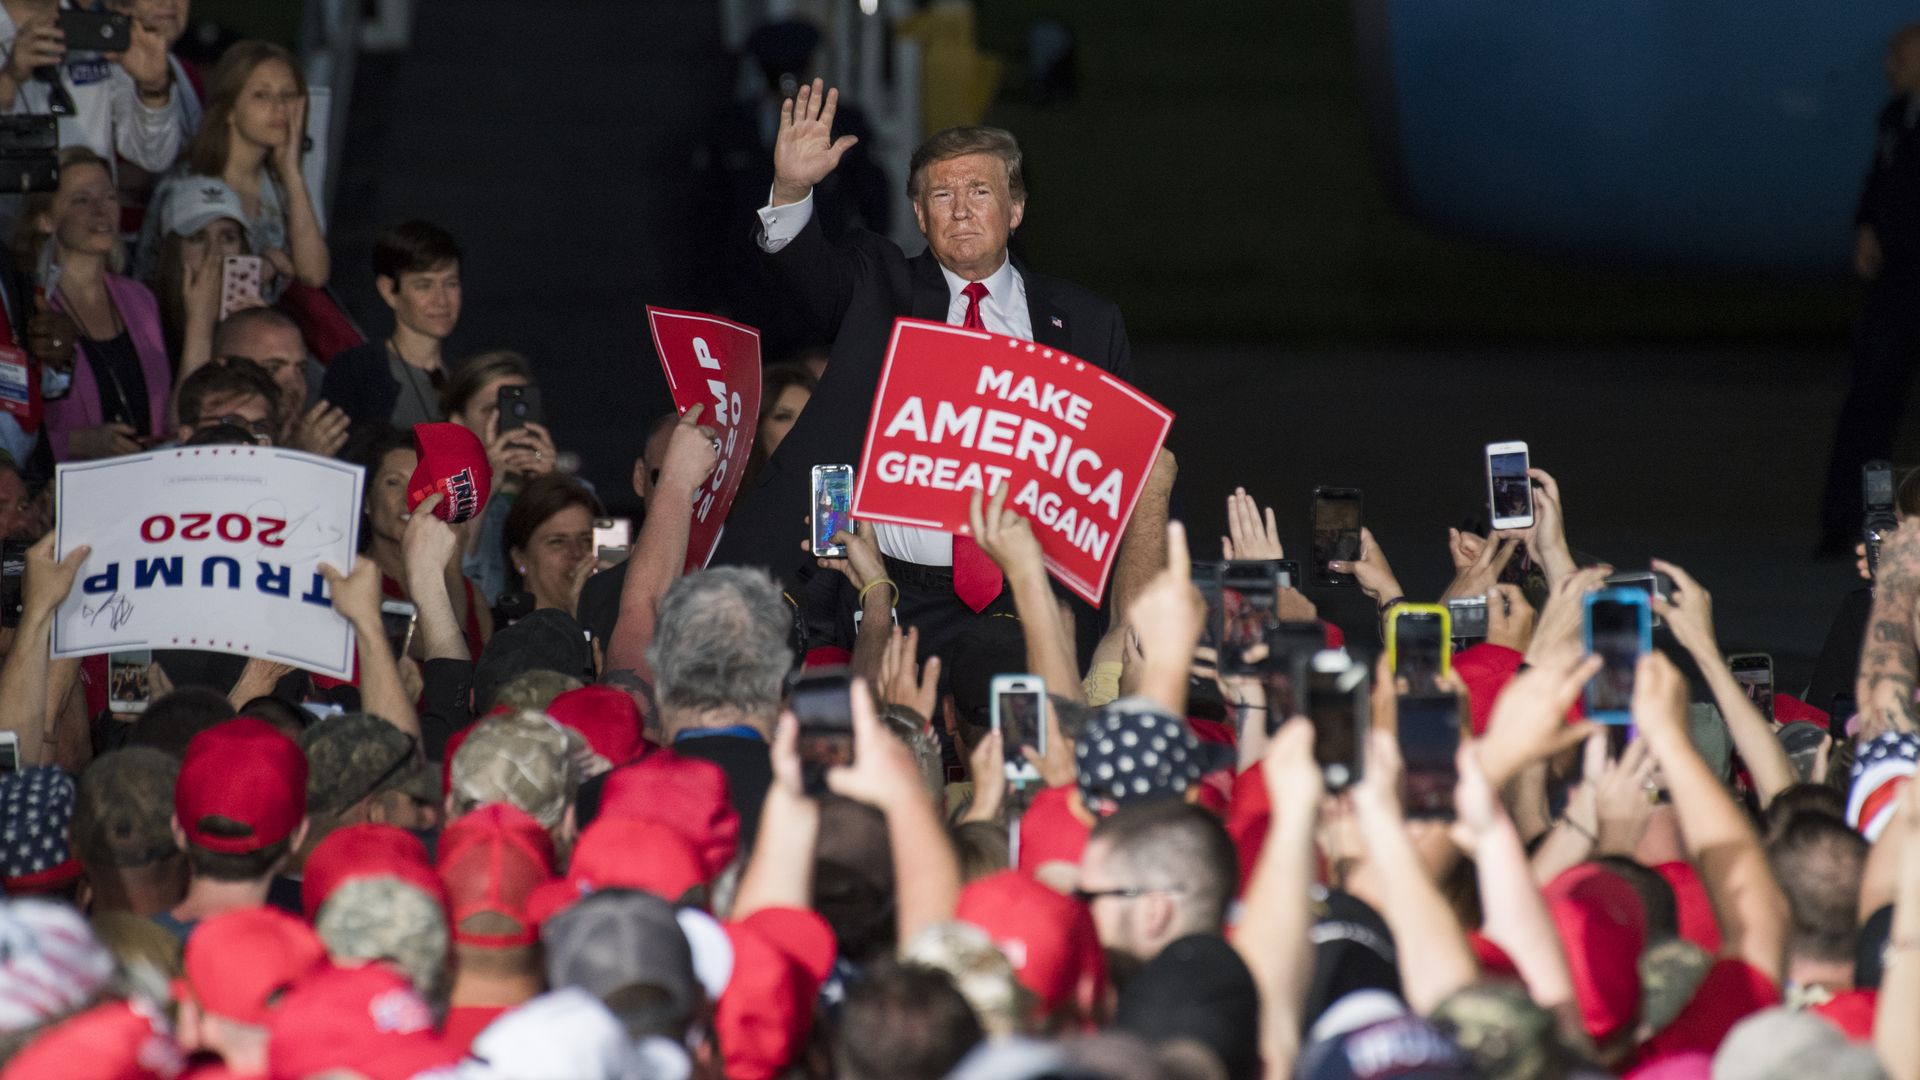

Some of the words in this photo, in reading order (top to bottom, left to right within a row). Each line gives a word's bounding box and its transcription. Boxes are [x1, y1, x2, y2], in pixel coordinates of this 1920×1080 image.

[975, 365, 1093, 431] MAKE
[697, 391, 741, 523] 2020
[883, 396, 1124, 519] AMERICA
[140, 513, 287, 548] 2020
[876, 451, 1012, 496] GREAT
[1014, 479, 1109, 561] AGAIN
[83, 556, 333, 608] TRUMP
